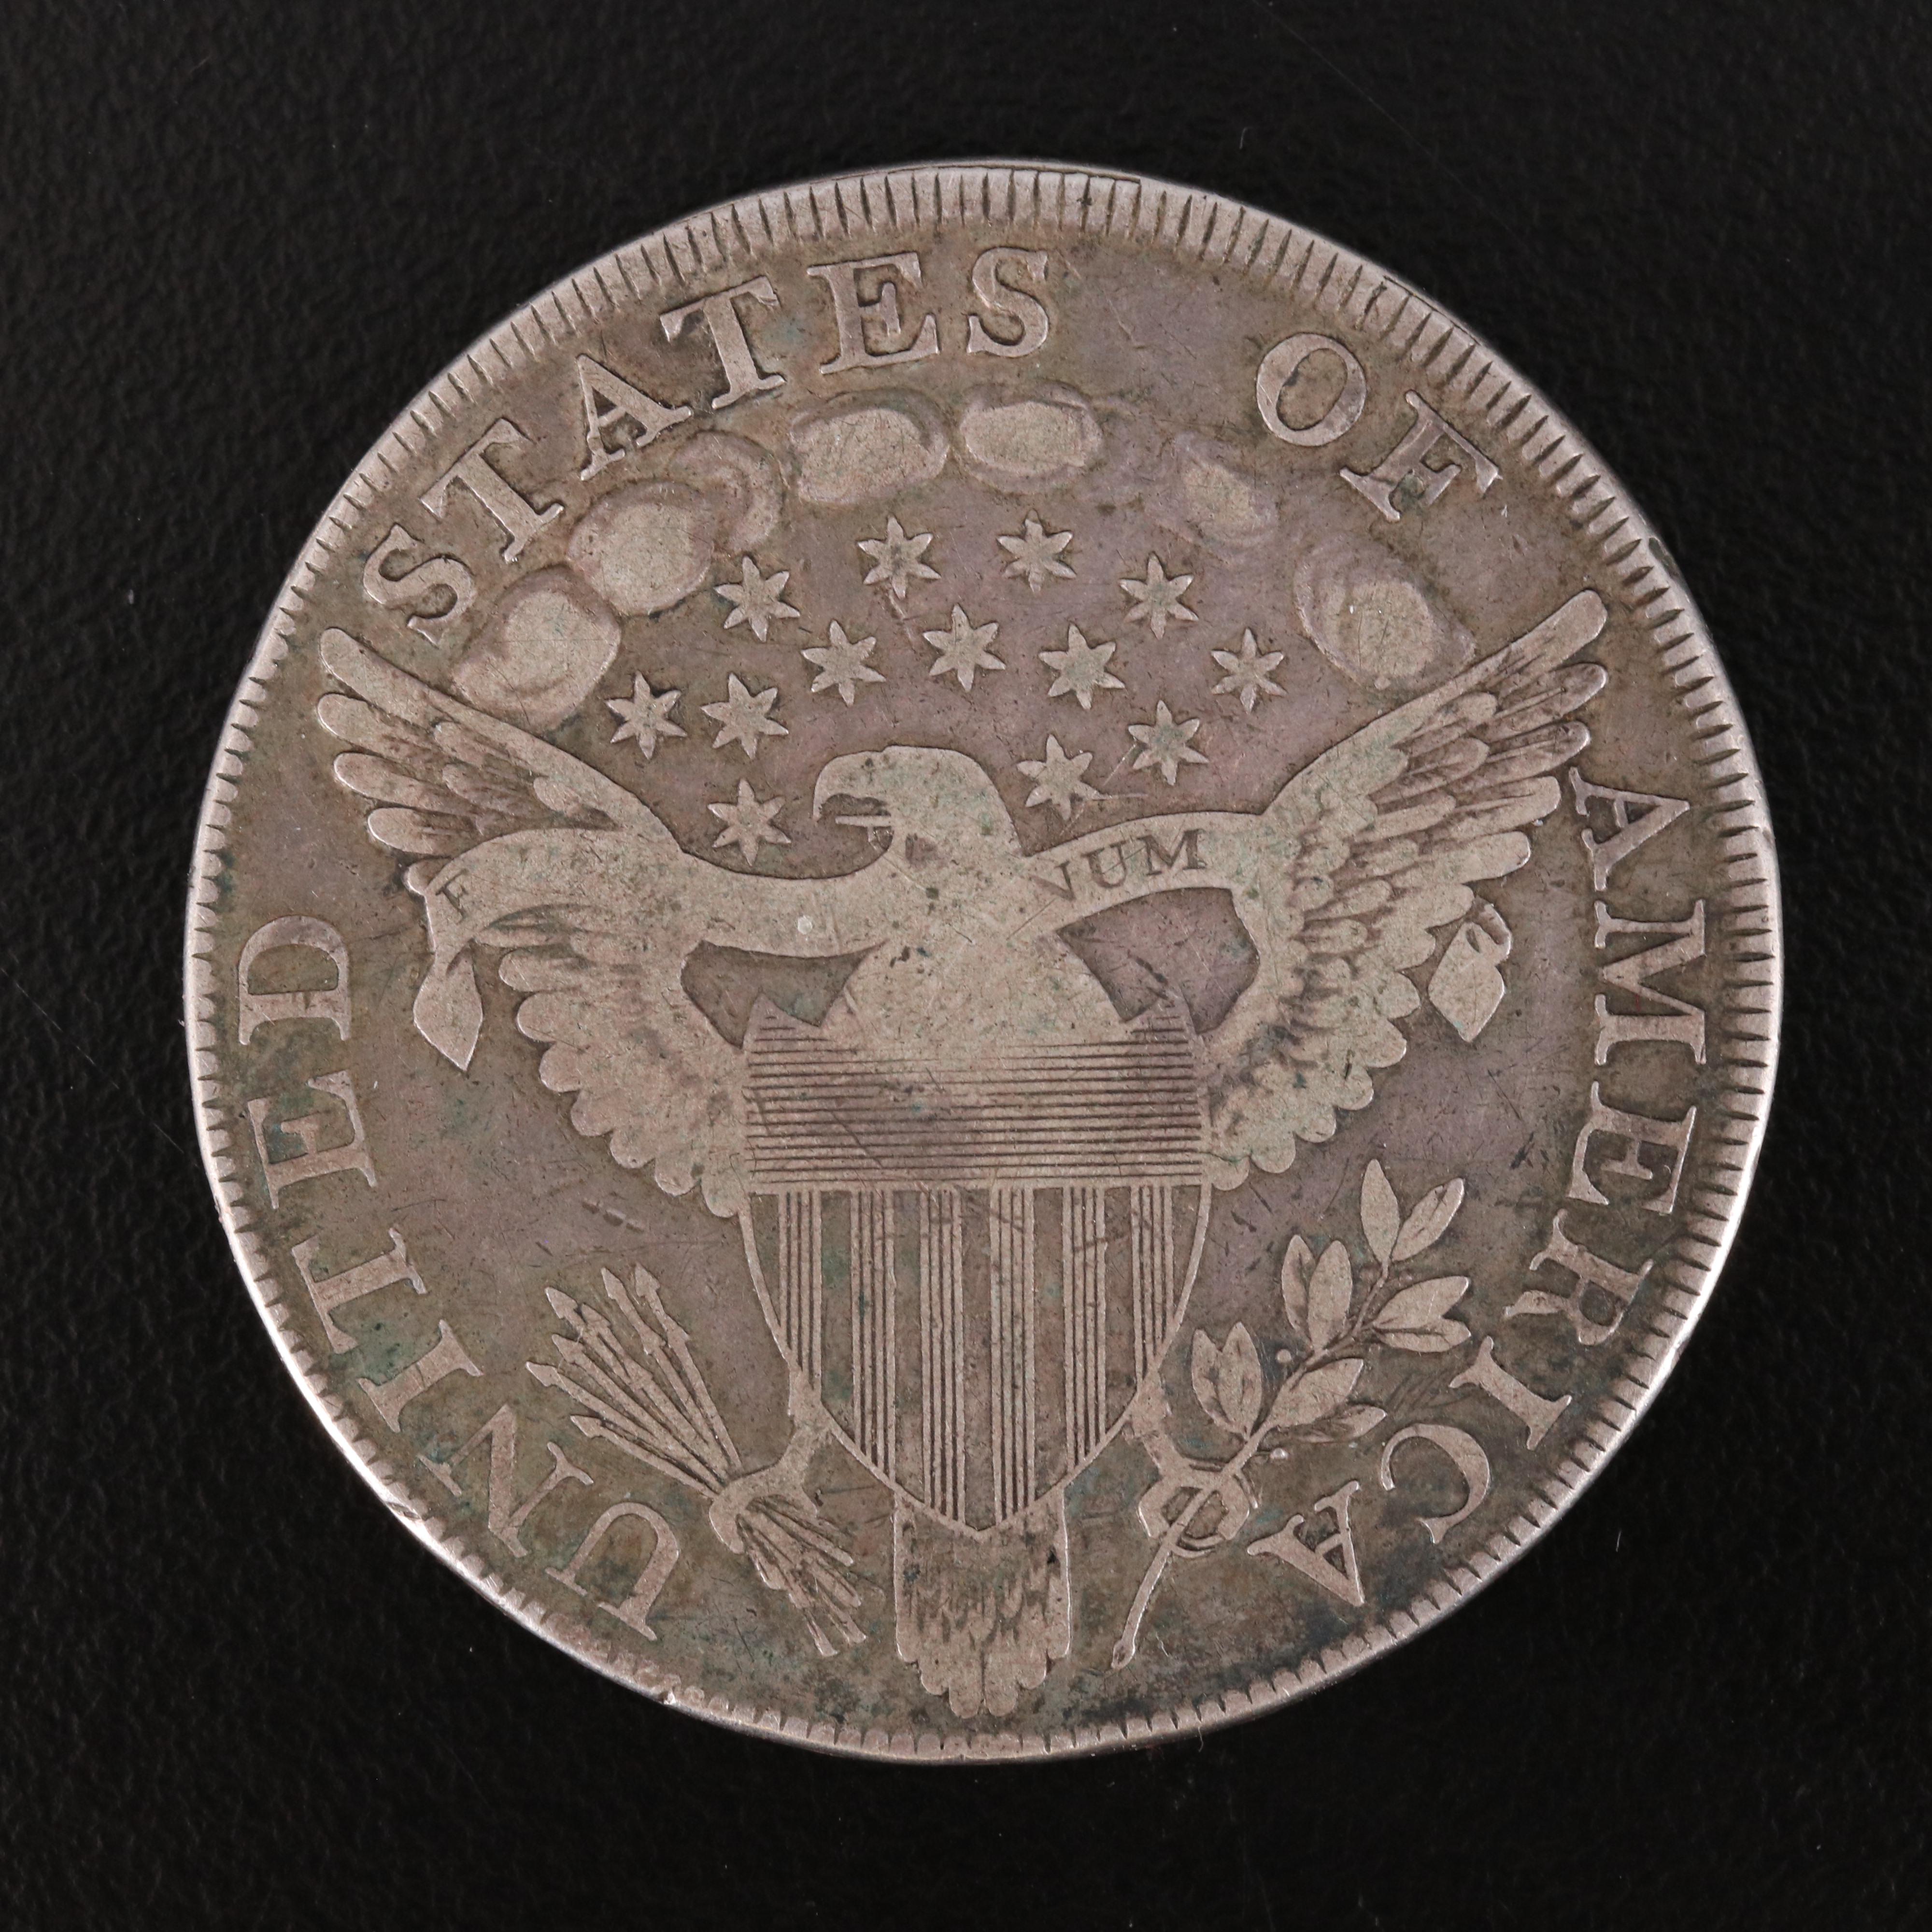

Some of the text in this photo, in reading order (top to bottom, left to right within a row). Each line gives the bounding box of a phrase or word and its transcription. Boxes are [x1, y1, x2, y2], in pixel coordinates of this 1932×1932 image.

[238, 246, 1707, 1641] UNITED STATES OF AMERICA
